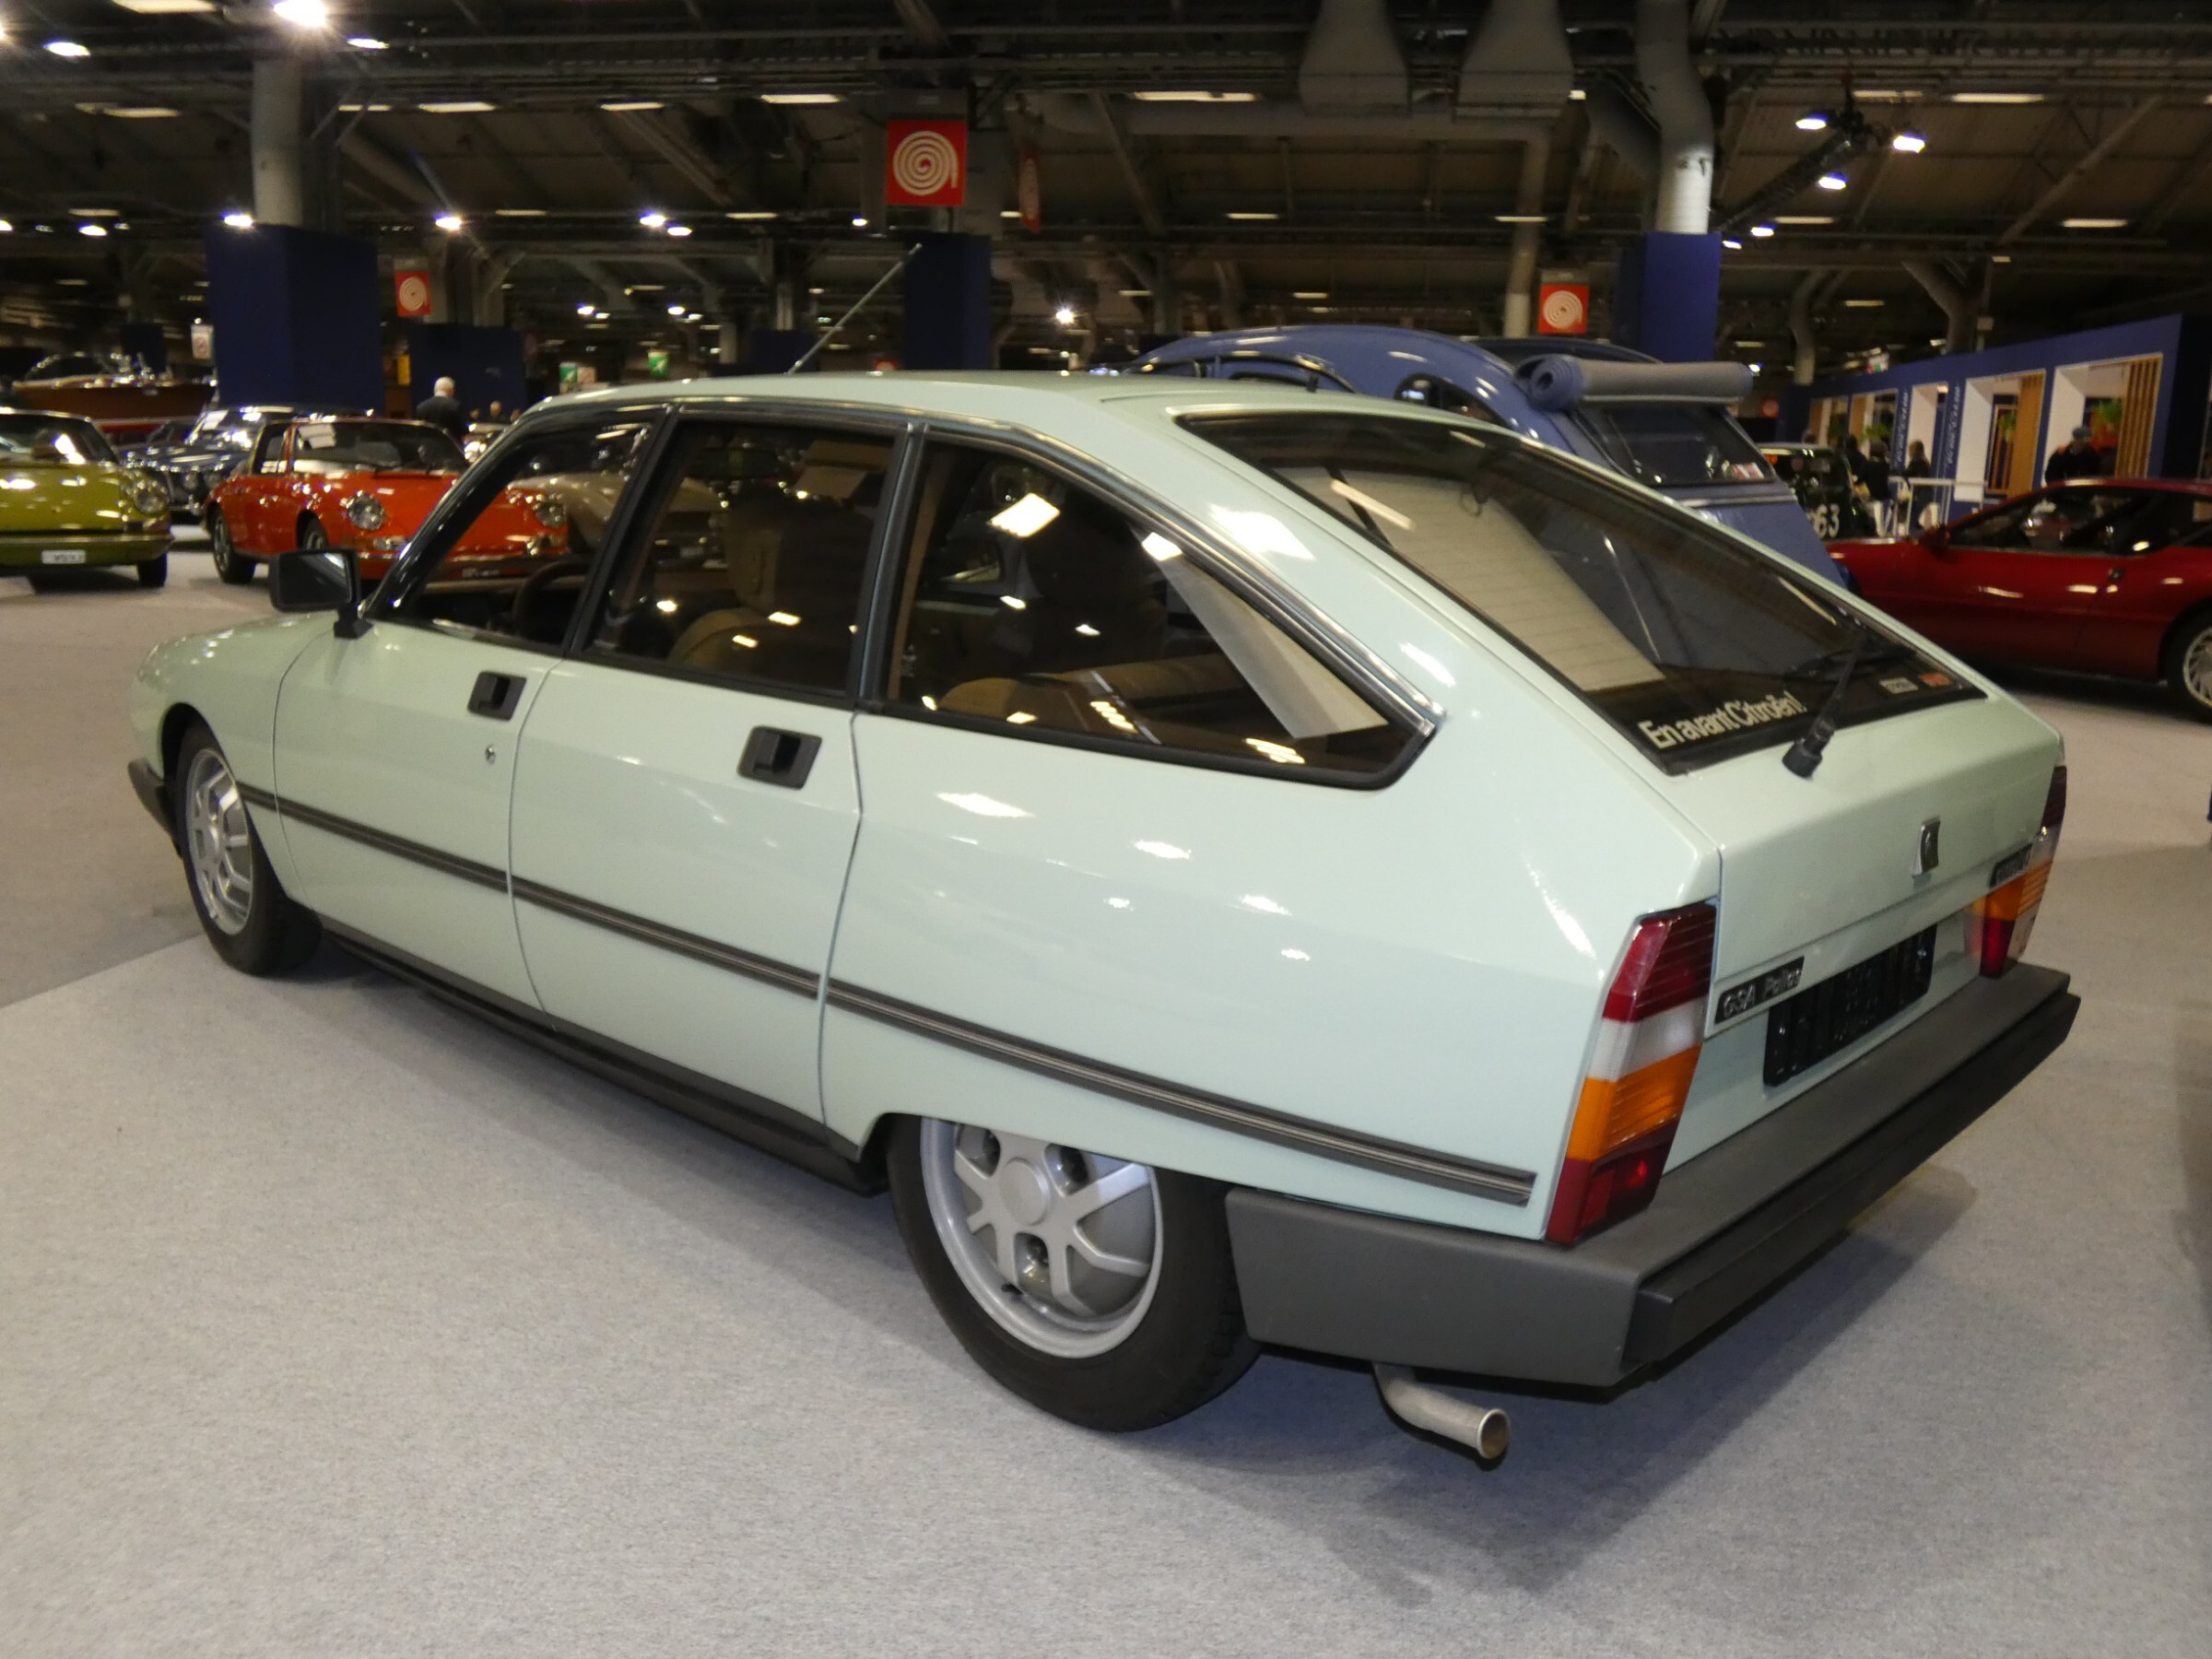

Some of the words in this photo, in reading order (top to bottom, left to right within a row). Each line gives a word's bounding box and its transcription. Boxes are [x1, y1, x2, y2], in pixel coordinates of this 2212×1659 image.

[1638, 720, 1686, 749] En
[1676, 708, 1741, 740] avant
[1723, 983, 1756, 1018] GSA
